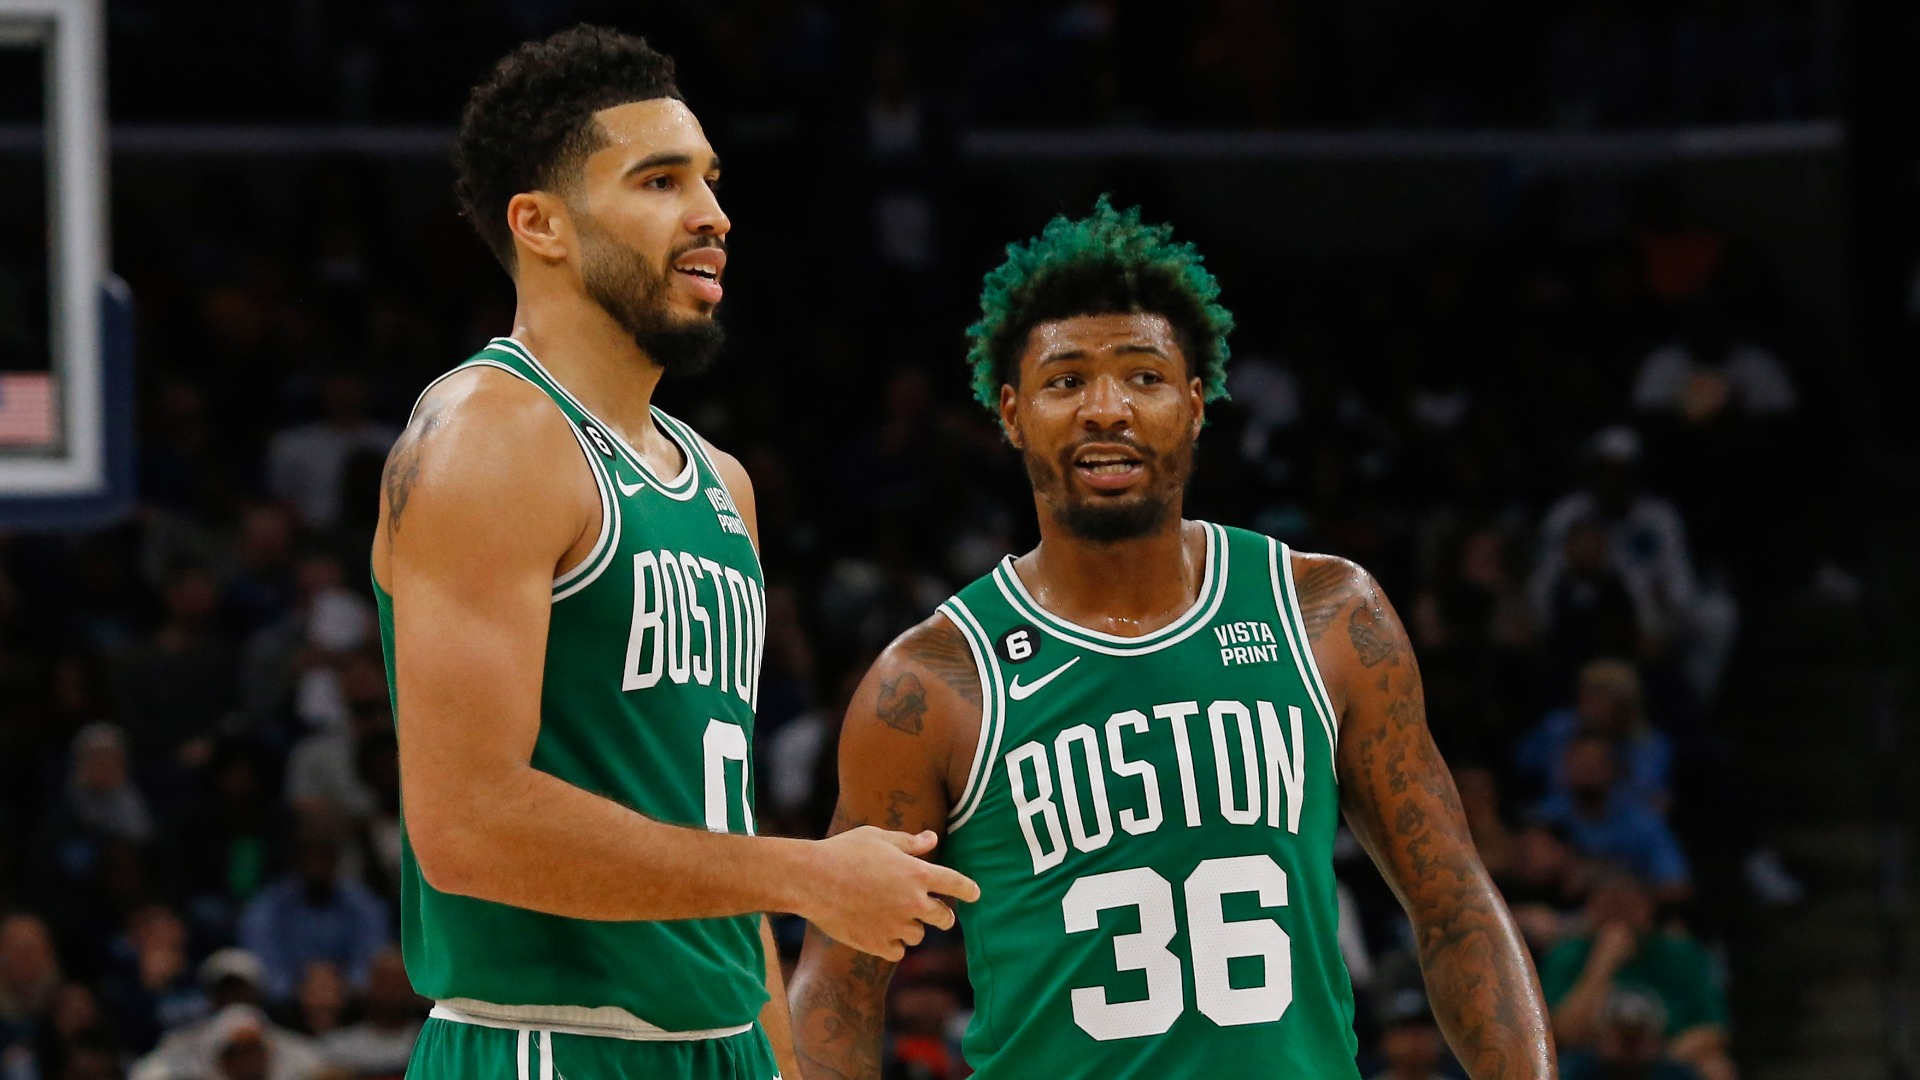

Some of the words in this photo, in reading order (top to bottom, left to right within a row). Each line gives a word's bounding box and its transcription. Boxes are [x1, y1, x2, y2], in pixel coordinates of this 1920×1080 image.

[585, 425, 613, 457] 6
[622, 549, 766, 714] BOSTON
[1005, 631, 1032, 661] 6
[1213, 621, 1277, 647] VISTA
[1220, 644, 1278, 666] PRINT
[1005, 700, 1304, 876] BOSTON
[1062, 854, 1293, 1041] 36
